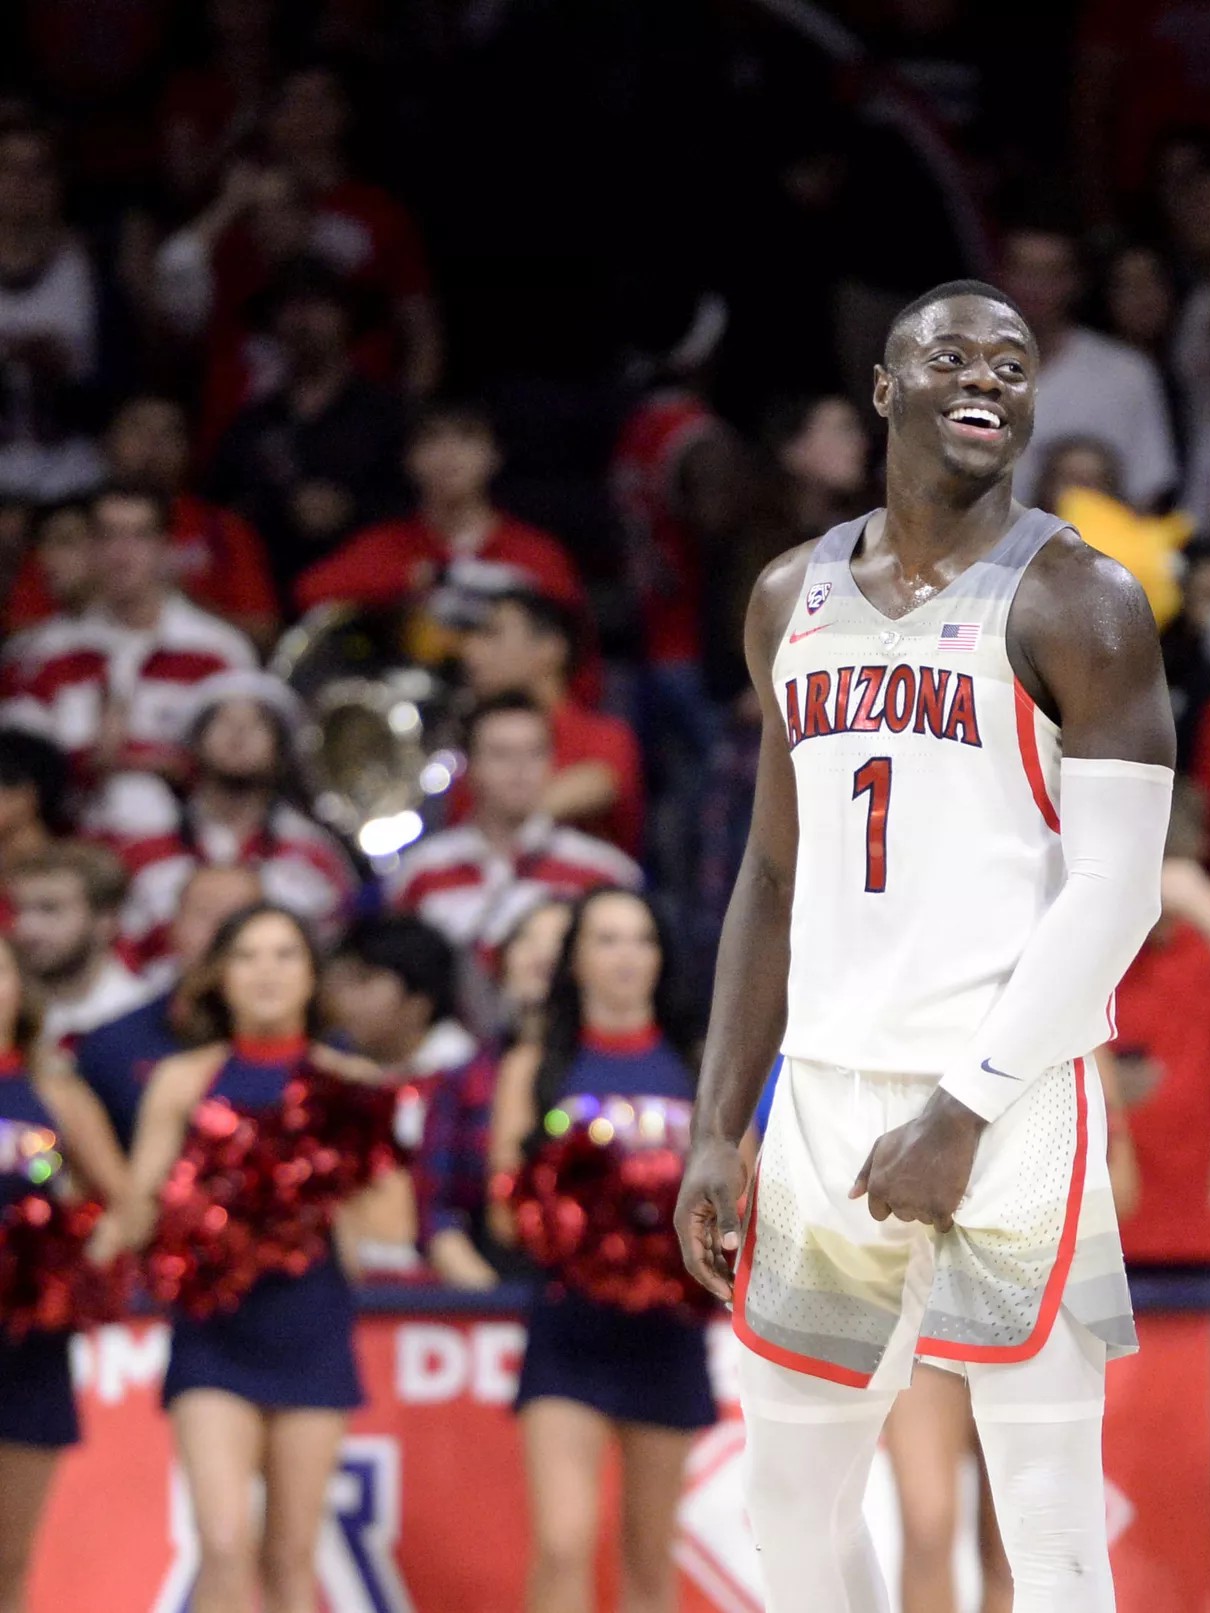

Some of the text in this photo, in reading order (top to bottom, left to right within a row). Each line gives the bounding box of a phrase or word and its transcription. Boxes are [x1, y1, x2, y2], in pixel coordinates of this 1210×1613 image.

[785, 664, 983, 752] ARIZONA
[851, 756, 893, 893] 1
[68, 1322, 173, 1403] M
